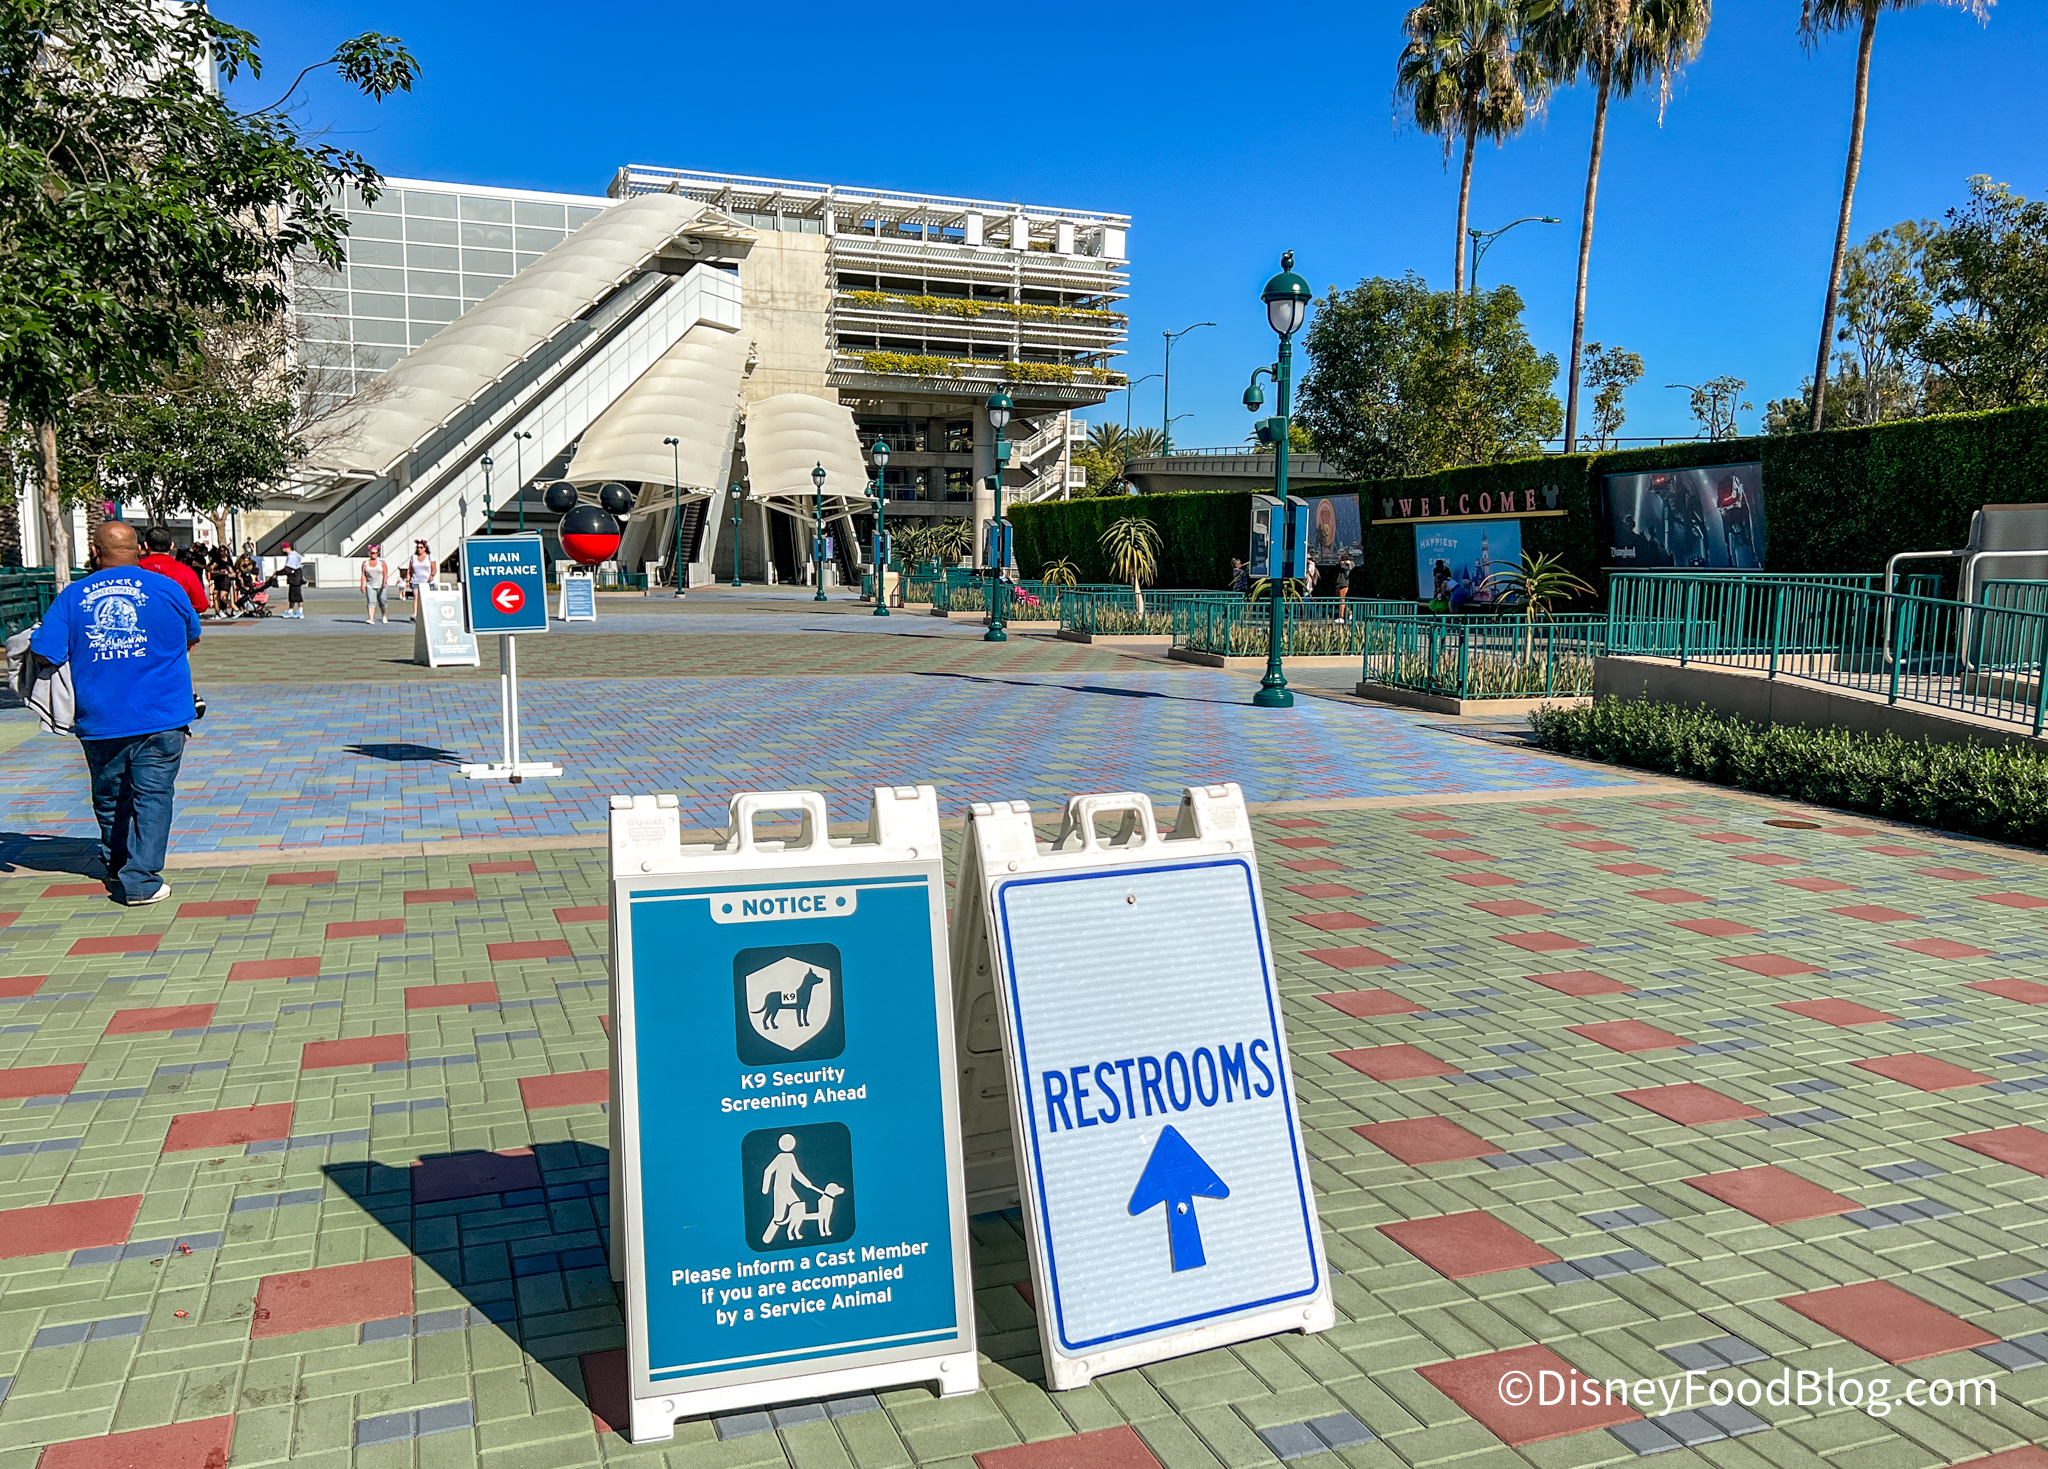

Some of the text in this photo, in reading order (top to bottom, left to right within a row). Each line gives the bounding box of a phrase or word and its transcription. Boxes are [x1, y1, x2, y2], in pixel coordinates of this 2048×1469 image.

[1399, 489, 1536, 517] WELCOME
[1419, 538, 1458, 550] HAPPIEST
[488, 552, 520, 563] MAIN
[473, 565, 537, 576] ENTRANCE
[92, 578, 132, 590] NEVER
[91, 647, 147, 663] JUNE
[743, 895, 826, 916] NOTICE
[783, 993, 796, 1001] K9
[741, 1066, 845, 1089] K9 Security
[1042, 1038, 1275, 1133] RESTROOMS
[721, 1084, 867, 1113] Screening Ahead
[671, 1241, 929, 1286] Please inform a Cast Member
[701, 1264, 904, 1305] if you are accompanied
[716, 1287, 892, 1327] by a Service Animal
